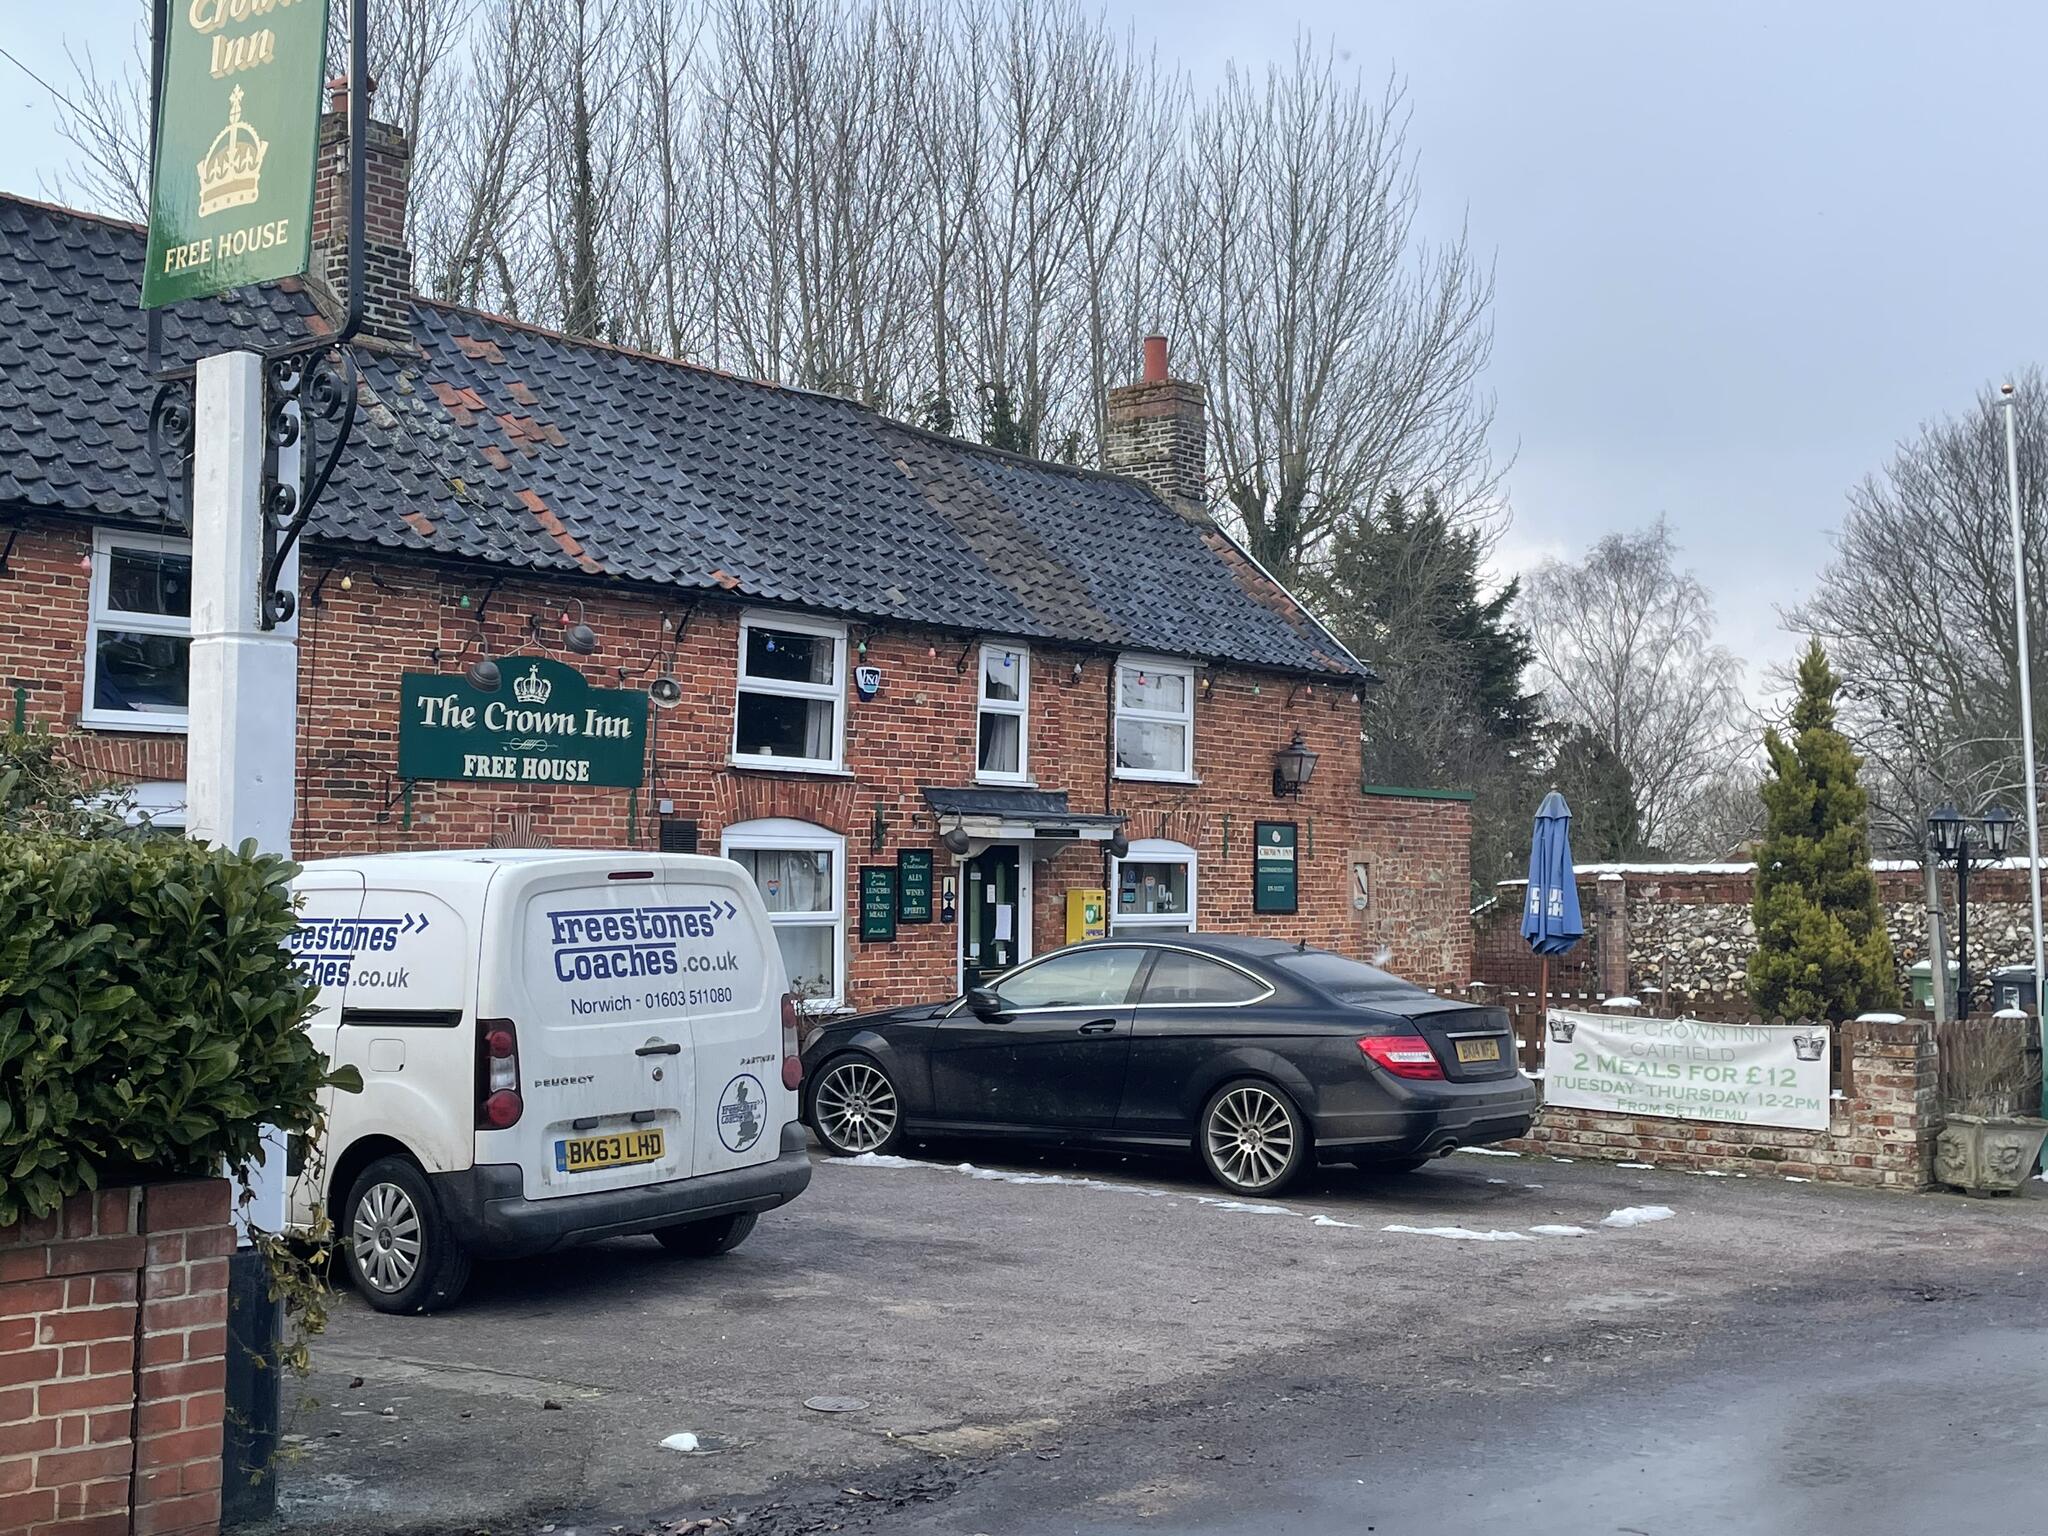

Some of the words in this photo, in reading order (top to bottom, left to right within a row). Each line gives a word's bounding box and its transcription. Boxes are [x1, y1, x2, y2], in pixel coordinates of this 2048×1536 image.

[189, 0, 302, 33] Cro
[209, 29, 275, 79] Inn
[164, 239, 212, 273] FREE
[218, 219, 289, 258] HOUSE
[417, 694, 476, 729] The
[484, 702, 577, 735] Crown
[582, 708, 632, 738] Inn
[463, 754, 517, 779] FREE
[522, 757, 590, 782] HOUSE
[907, 873, 923, 881] ALES
[547, 906, 715, 944] Freestones
[554, 942, 678, 982] Coaches
[683, 952, 739, 973] .co.uk
[352, 967, 410, 988] .co.uk
[571, 995, 632, 1015] Norwich
[645, 990, 686, 1008] 01603
[689, 987, 732, 1005] 511080
[1599, 1018, 1638, 1036] THE
[1643, 1021, 1727, 1041] CROWN
[1734, 1027, 1772, 1043] INN
[1630, 1042, 1736, 1063] CATFIELD
[534, 1075, 595, 1088] PEUGEOT
[1574, 1053, 1589, 1071] 2
[1597, 1056, 1681, 1079] MEALS
[1689, 1065, 1738, 1083] FOR
[1746, 1066, 1798, 1088] £12
[1554, 1075, 1634, 1094] TUESDAY
[1646, 1084, 1749, 1105] THURSDAY
[569, 1139, 621, 1164] BK63
[626, 1134, 661, 1157] LHD
